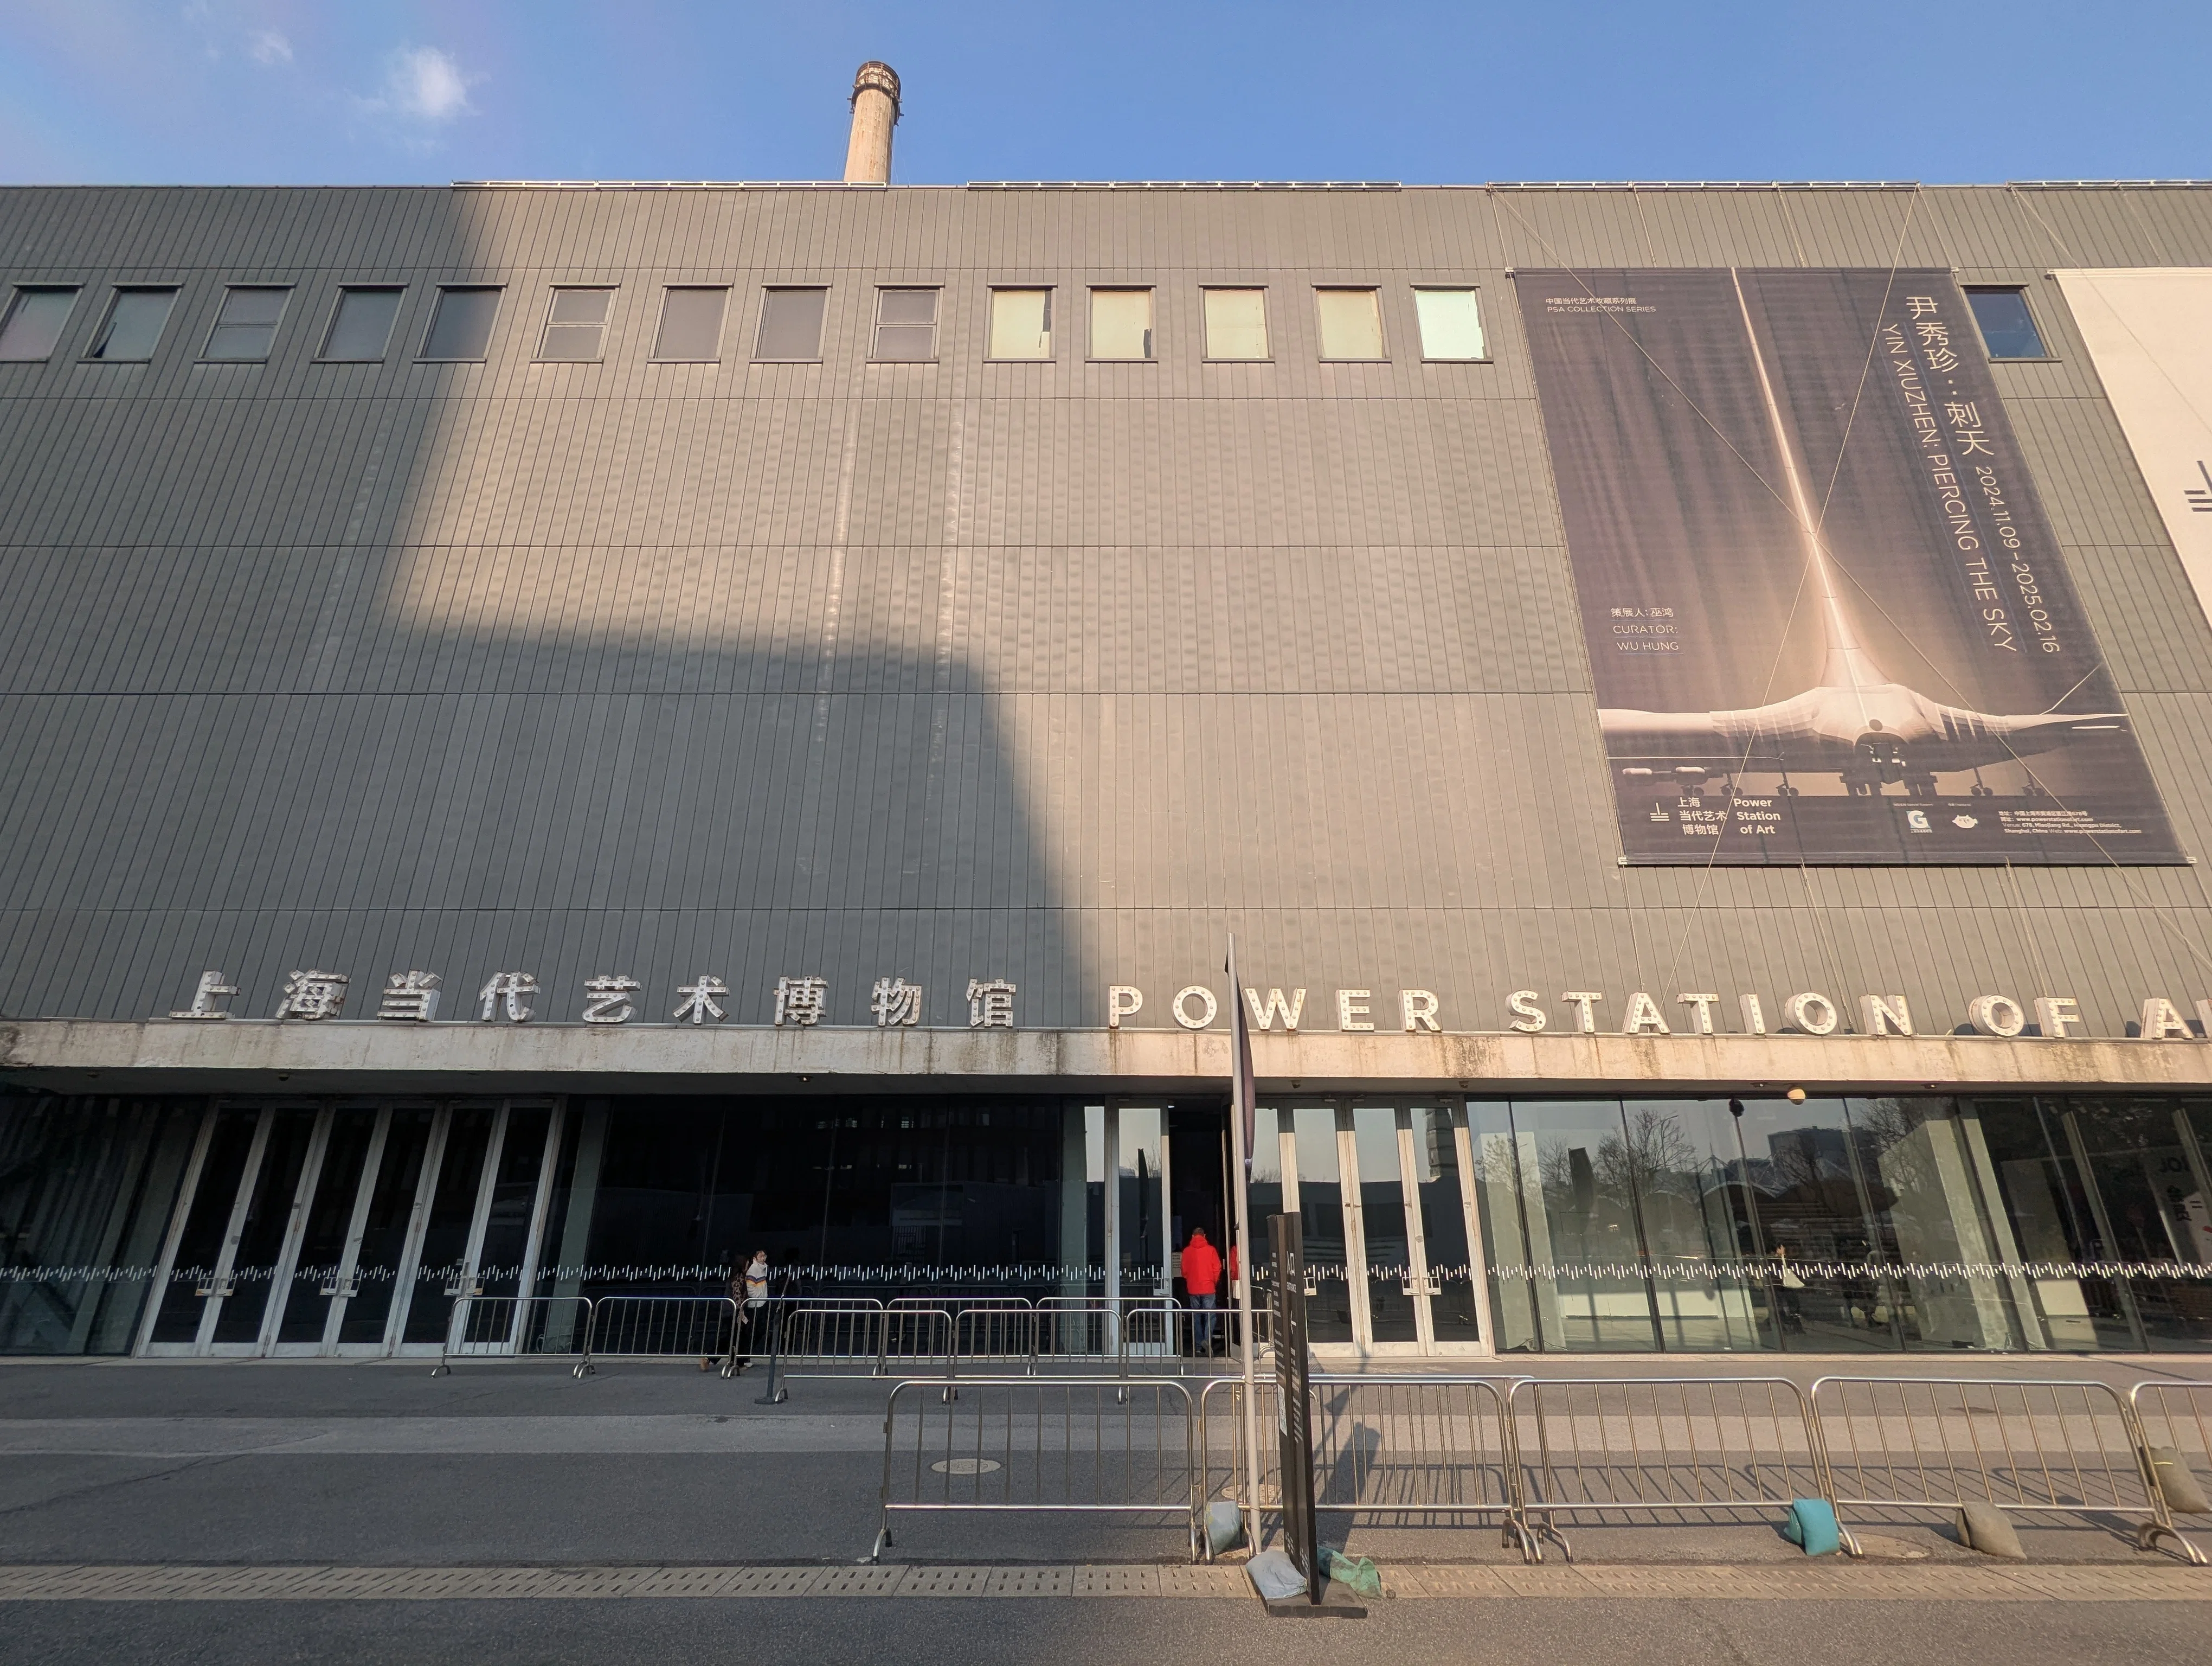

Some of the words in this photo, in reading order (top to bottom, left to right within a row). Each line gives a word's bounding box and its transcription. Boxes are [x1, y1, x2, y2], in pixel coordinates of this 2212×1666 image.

[1882, 324, 1908, 354] YIN
[1893, 360, 1941, 448] XIUZHEN:
[1927, 454, 1979, 550] PIERCING
[1966, 557, 1998, 601] THE
[1613, 625, 1679, 634] CURATOR:
[1983, 608, 2017, 652] SKY
[1617, 642, 1638, 650] WU
[1643, 642, 1679, 650] HUNG
[1677, 797, 1701, 808] 上海
[1733, 798, 1772, 807] Power
[1679, 810, 1727, 822] 当代艺术
[1737, 811, 1781, 821] Station
[1682, 824, 1719, 835] 博物馆
[1740, 824, 1753, 834] of
[1757, 824, 1776, 834] Art
[169, 968, 1017, 1028] 上海当代艺术博物馆
[1108, 984, 1443, 1033] POWER
[1505, 990, 1914, 1037] STATION
[1968, 994, 2081, 1038] OF
[2140, 997, 2212, 1040] A
